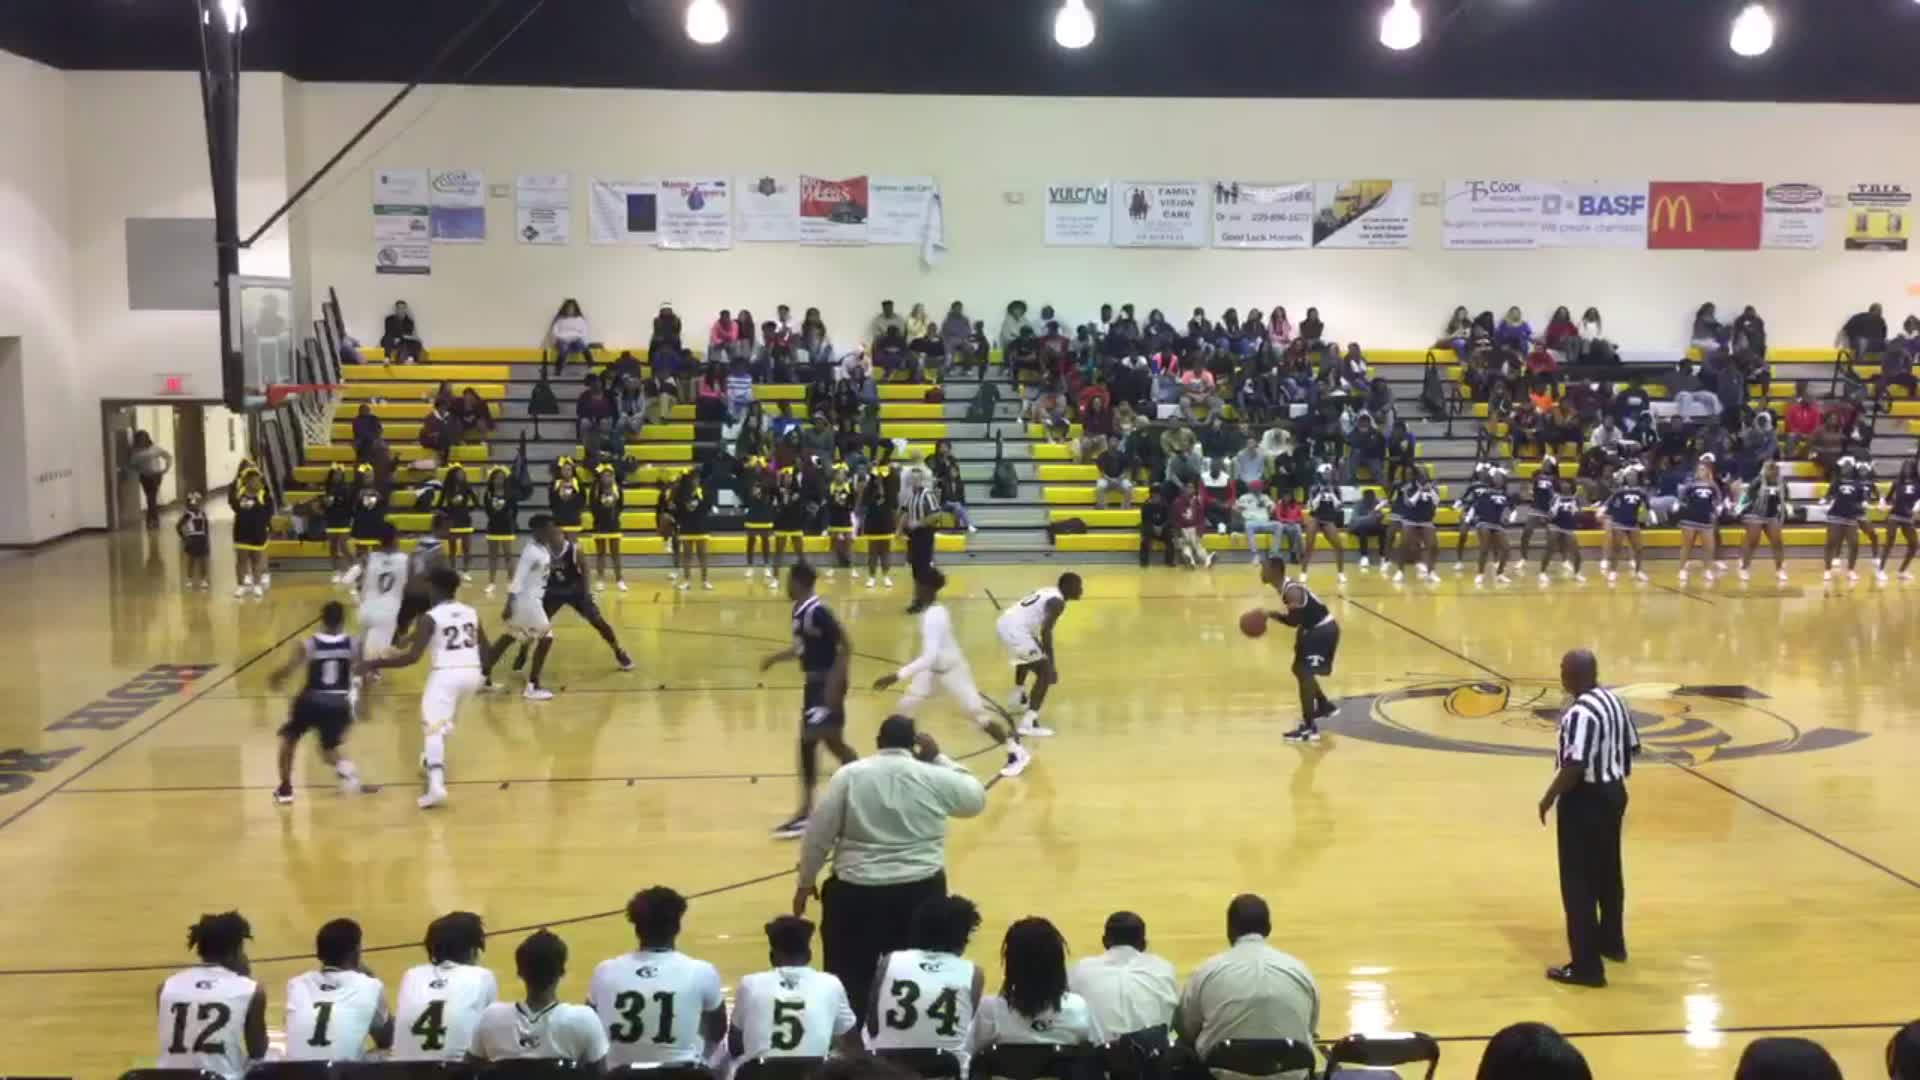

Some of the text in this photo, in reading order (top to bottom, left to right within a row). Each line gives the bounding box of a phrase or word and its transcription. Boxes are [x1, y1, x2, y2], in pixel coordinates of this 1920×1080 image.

[1049, 187, 1108, 200] VULCAN
[1158, 188, 1196, 196] FAMILY
[1489, 181, 1521, 193] Cook
[1160, 199, 1195, 207] VISION
[1162, 211, 1191, 219] CARE
[1579, 195, 1645, 216] BASF
[443, 622, 476, 650] 23
[610, 990, 676, 1043] 31
[886, 979, 959, 1037] 34
[168, 1002, 231, 1054] 12
[307, 1001, 335, 1047] 1
[411, 1000, 447, 1051] 4
[771, 998, 805, 1050] 5
